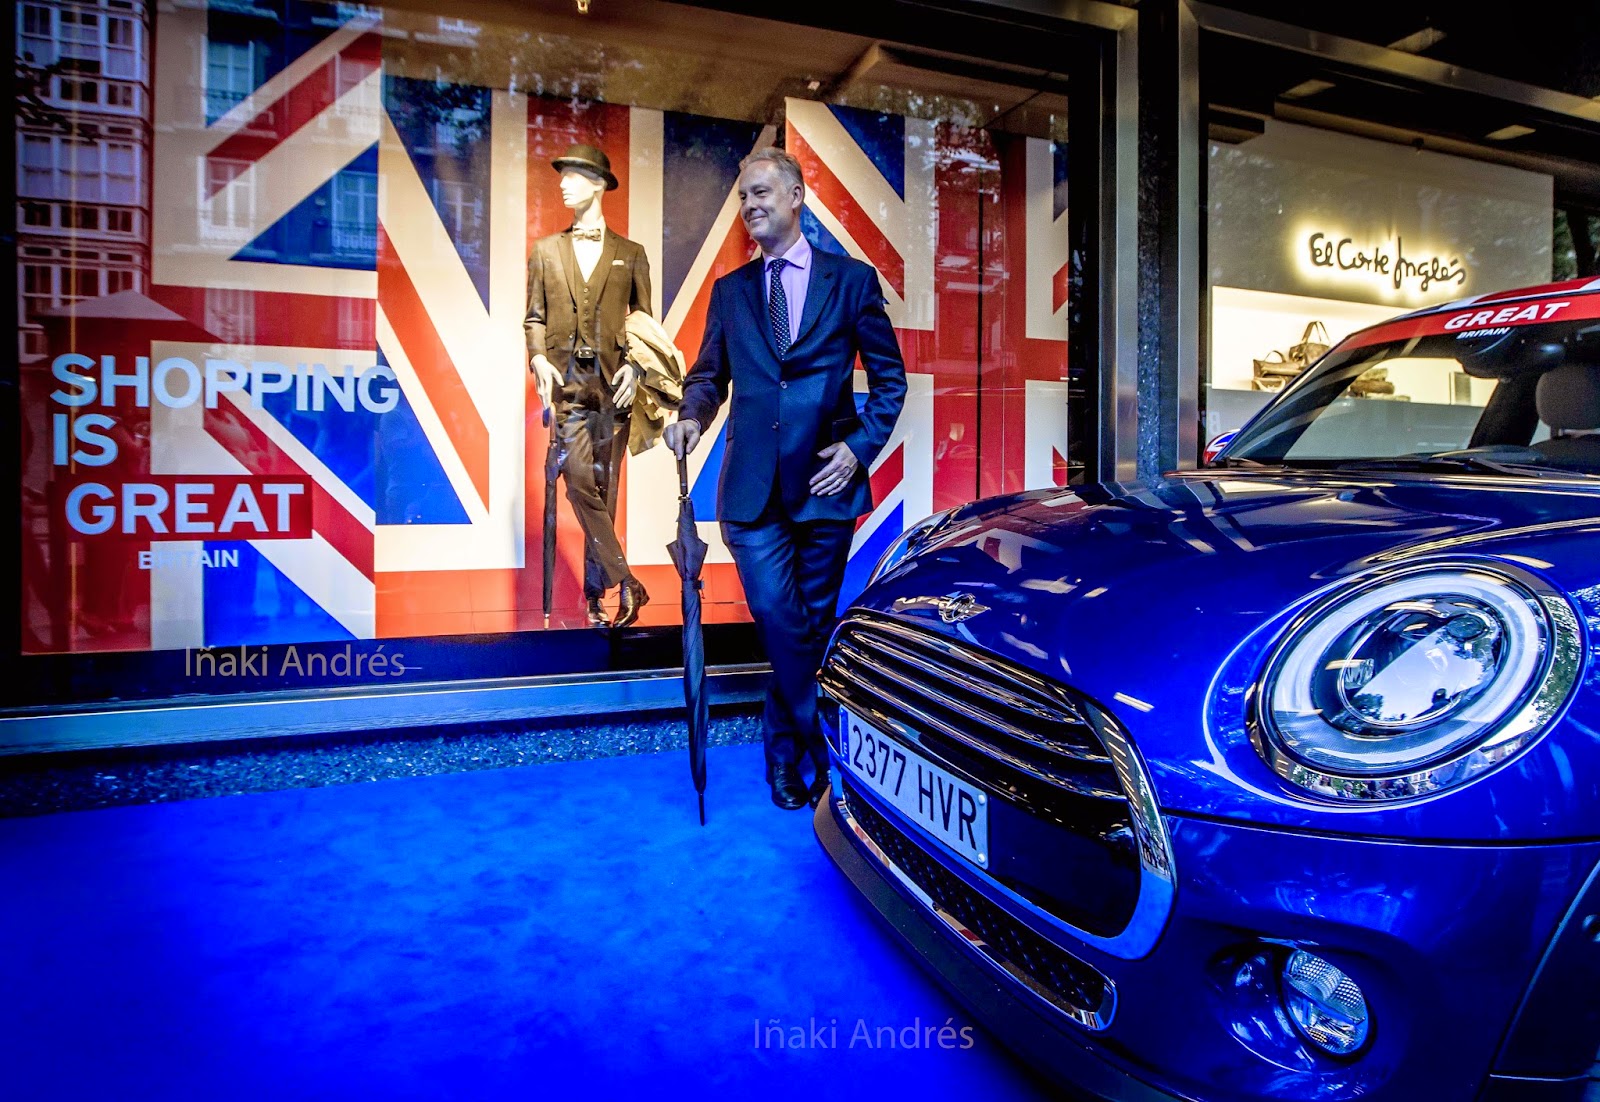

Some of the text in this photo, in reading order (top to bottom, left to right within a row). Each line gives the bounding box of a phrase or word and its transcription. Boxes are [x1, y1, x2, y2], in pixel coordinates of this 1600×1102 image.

[1309, 232, 1467, 291] El Corte Inglés
[1444, 302, 1571, 330] GREAT
[1456, 327, 1511, 340] BRITAIN
[50, 353, 401, 414] SHOPPING
[53, 413, 118, 467] IS
[65, 482, 305, 535] GREAT
[852, 724, 978, 850] 2377 HVR
